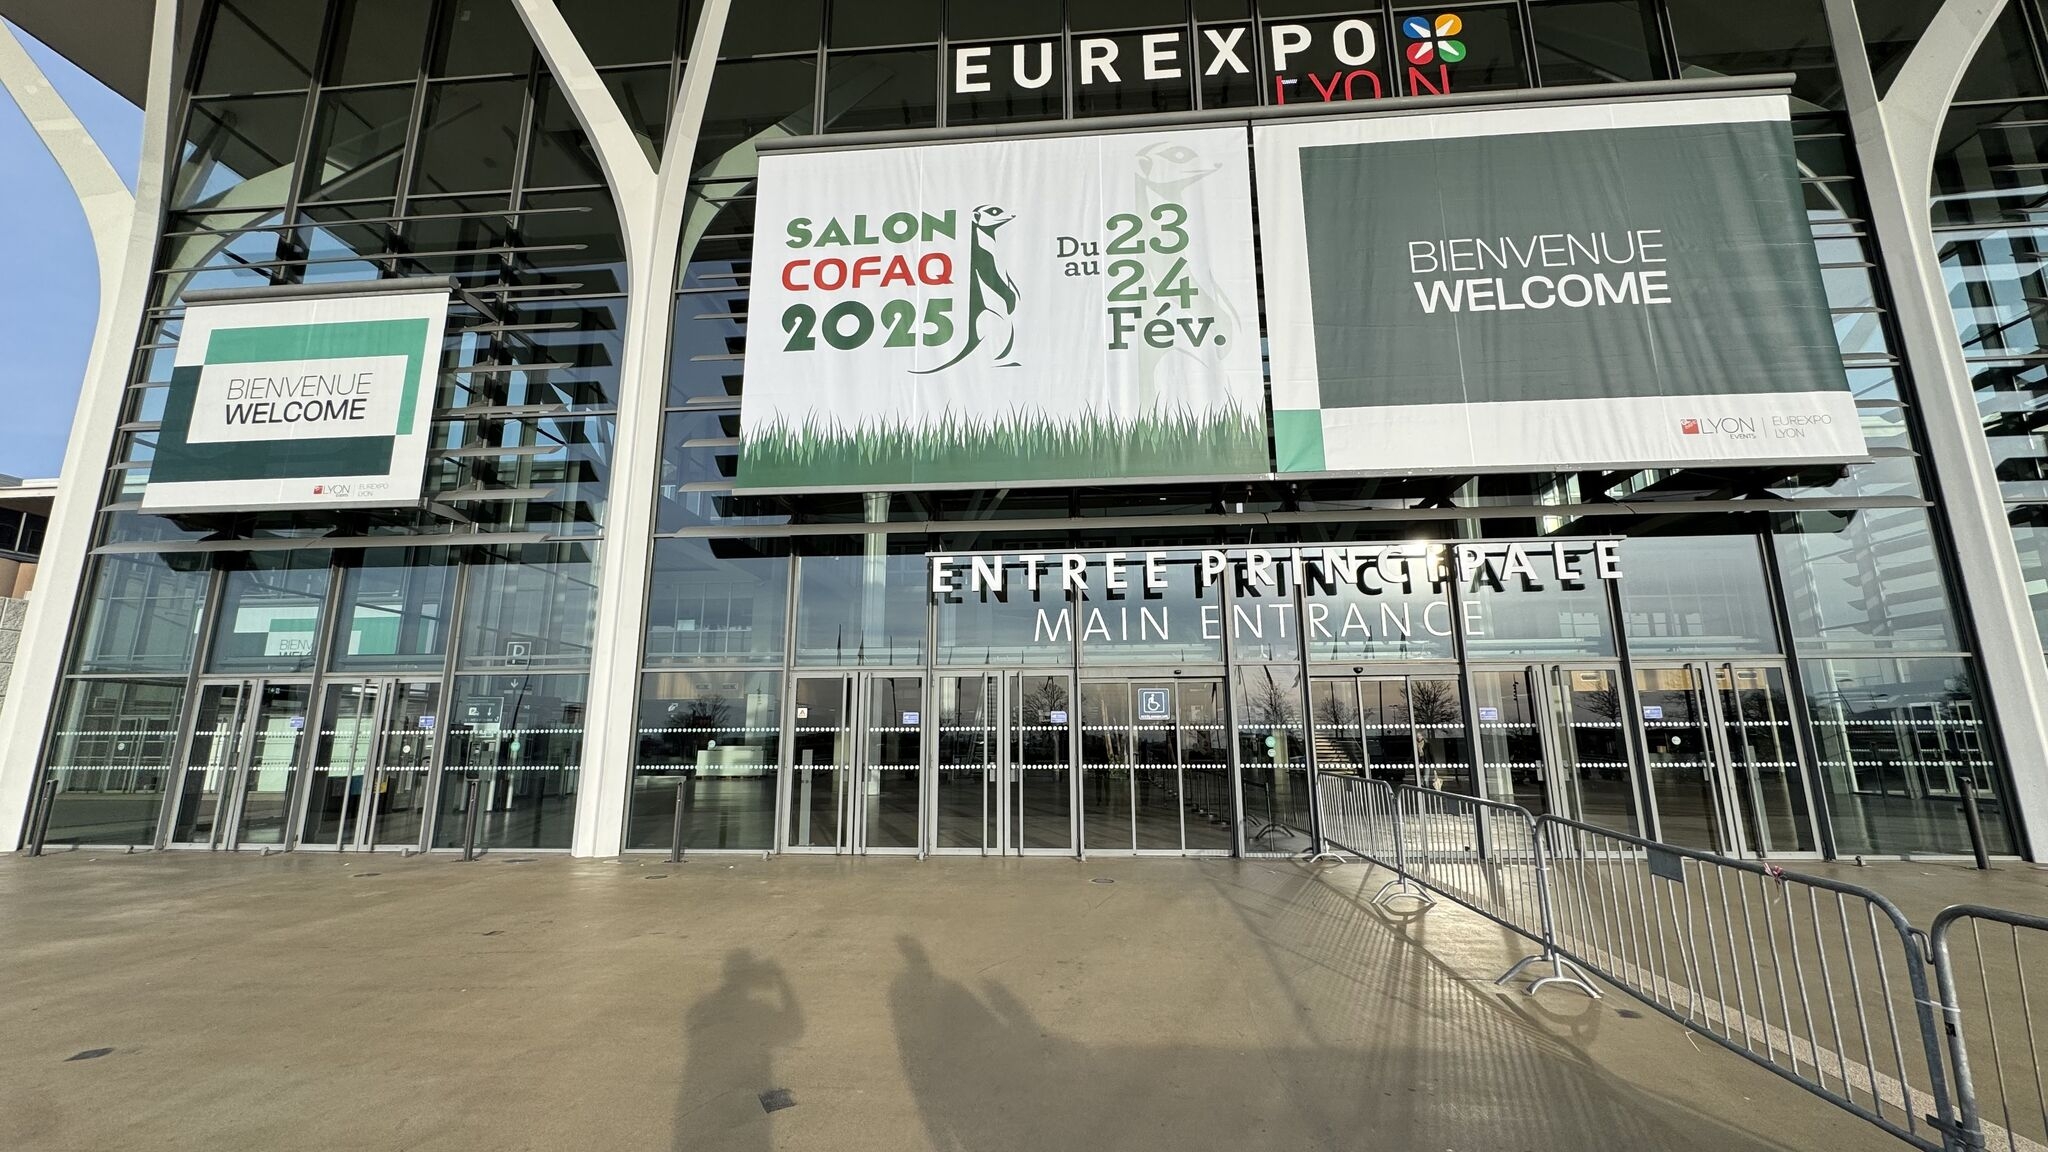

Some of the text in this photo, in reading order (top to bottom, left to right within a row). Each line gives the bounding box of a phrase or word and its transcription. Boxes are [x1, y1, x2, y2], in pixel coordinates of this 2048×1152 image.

[954, 18, 1377, 94] EUREXPO
[785, 208, 957, 249] SALON
[1056, 202, 1189, 259] Du 23
[781, 252, 954, 292] COFAQ
[1408, 229, 1667, 274] BIENVENUE
[1064, 256, 1199, 309] au 24
[1413, 270, 1672, 314] WELCOME
[781, 297, 955, 353] 2025
[1107, 302, 1228, 351] Fév.
[226, 372, 375, 400] BIENVENUE
[225, 397, 368, 425] WELCOME
[1700, 416, 1756, 435] LYON
[1772, 414, 1832, 426] EUREXPO
[1775, 427, 1806, 438] LYON
[323, 484, 351, 495] LYON
[931, 540, 1625, 594] ENTREE PRINCIPALE
[1033, 600, 1485, 642] MAIN ENTRANCE
[279, 639, 313, 651] BIENV
